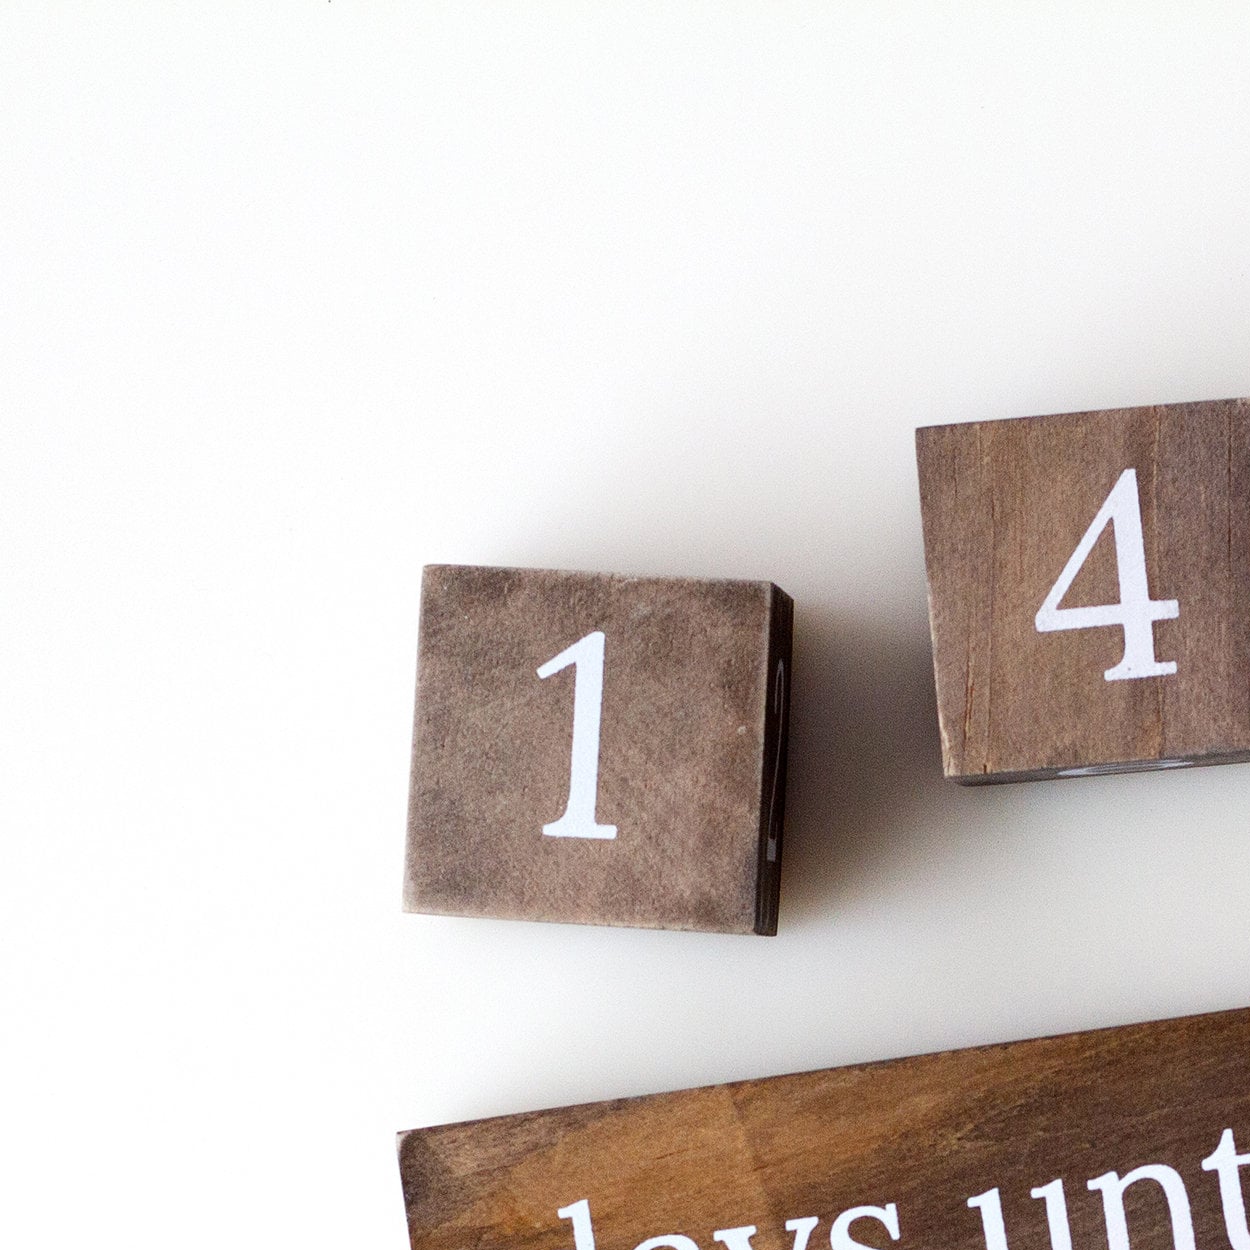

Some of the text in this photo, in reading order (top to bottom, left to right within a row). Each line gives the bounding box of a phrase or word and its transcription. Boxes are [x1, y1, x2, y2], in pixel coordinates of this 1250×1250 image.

[1034, 468, 1180, 682] 4
[535, 630, 619, 841] 1
[766, 658, 785, 863] 2
